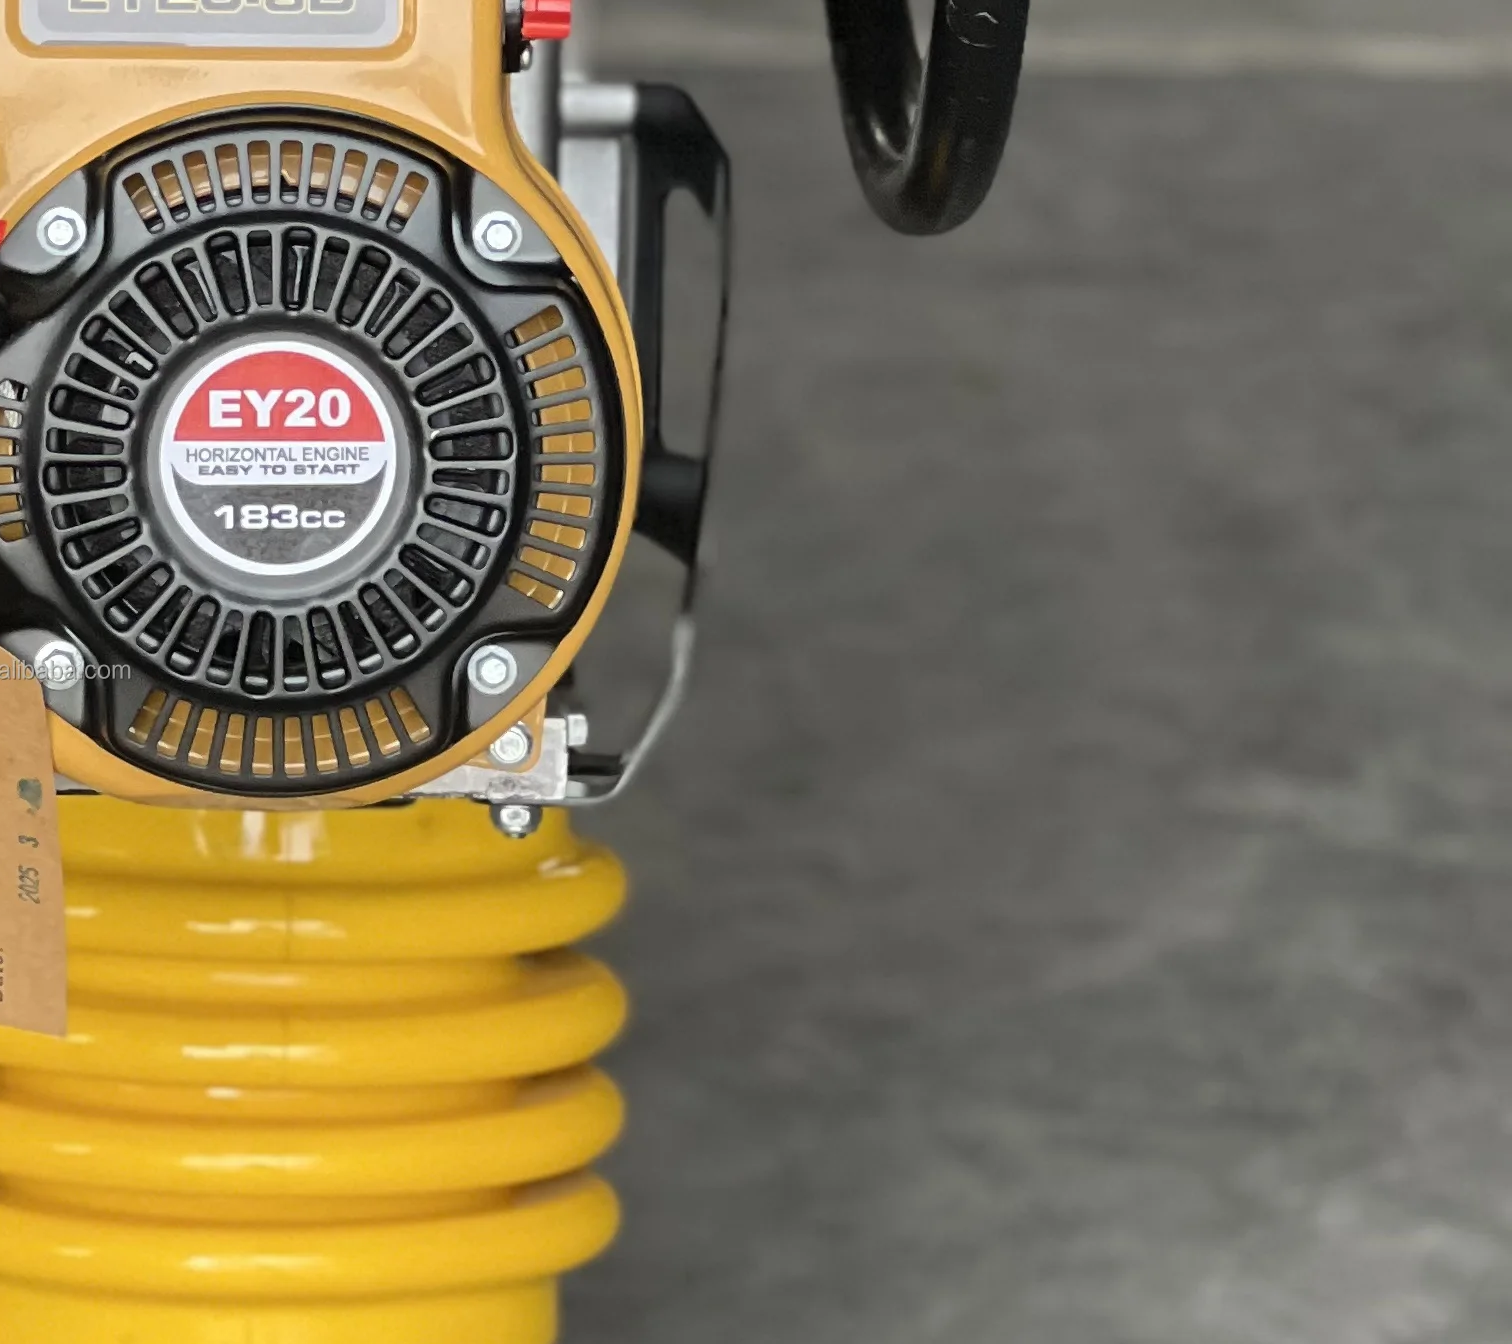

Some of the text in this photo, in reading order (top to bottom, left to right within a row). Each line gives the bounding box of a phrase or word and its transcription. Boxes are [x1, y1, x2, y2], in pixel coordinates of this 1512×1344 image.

[208, 388, 351, 428] EY20
[185, 446, 369, 463] HORIZONTAL ENGINE
[198, 463, 360, 476] EASY TO START
[214, 504, 346, 529] 183cc
[18, 864, 40, 904] 2025
